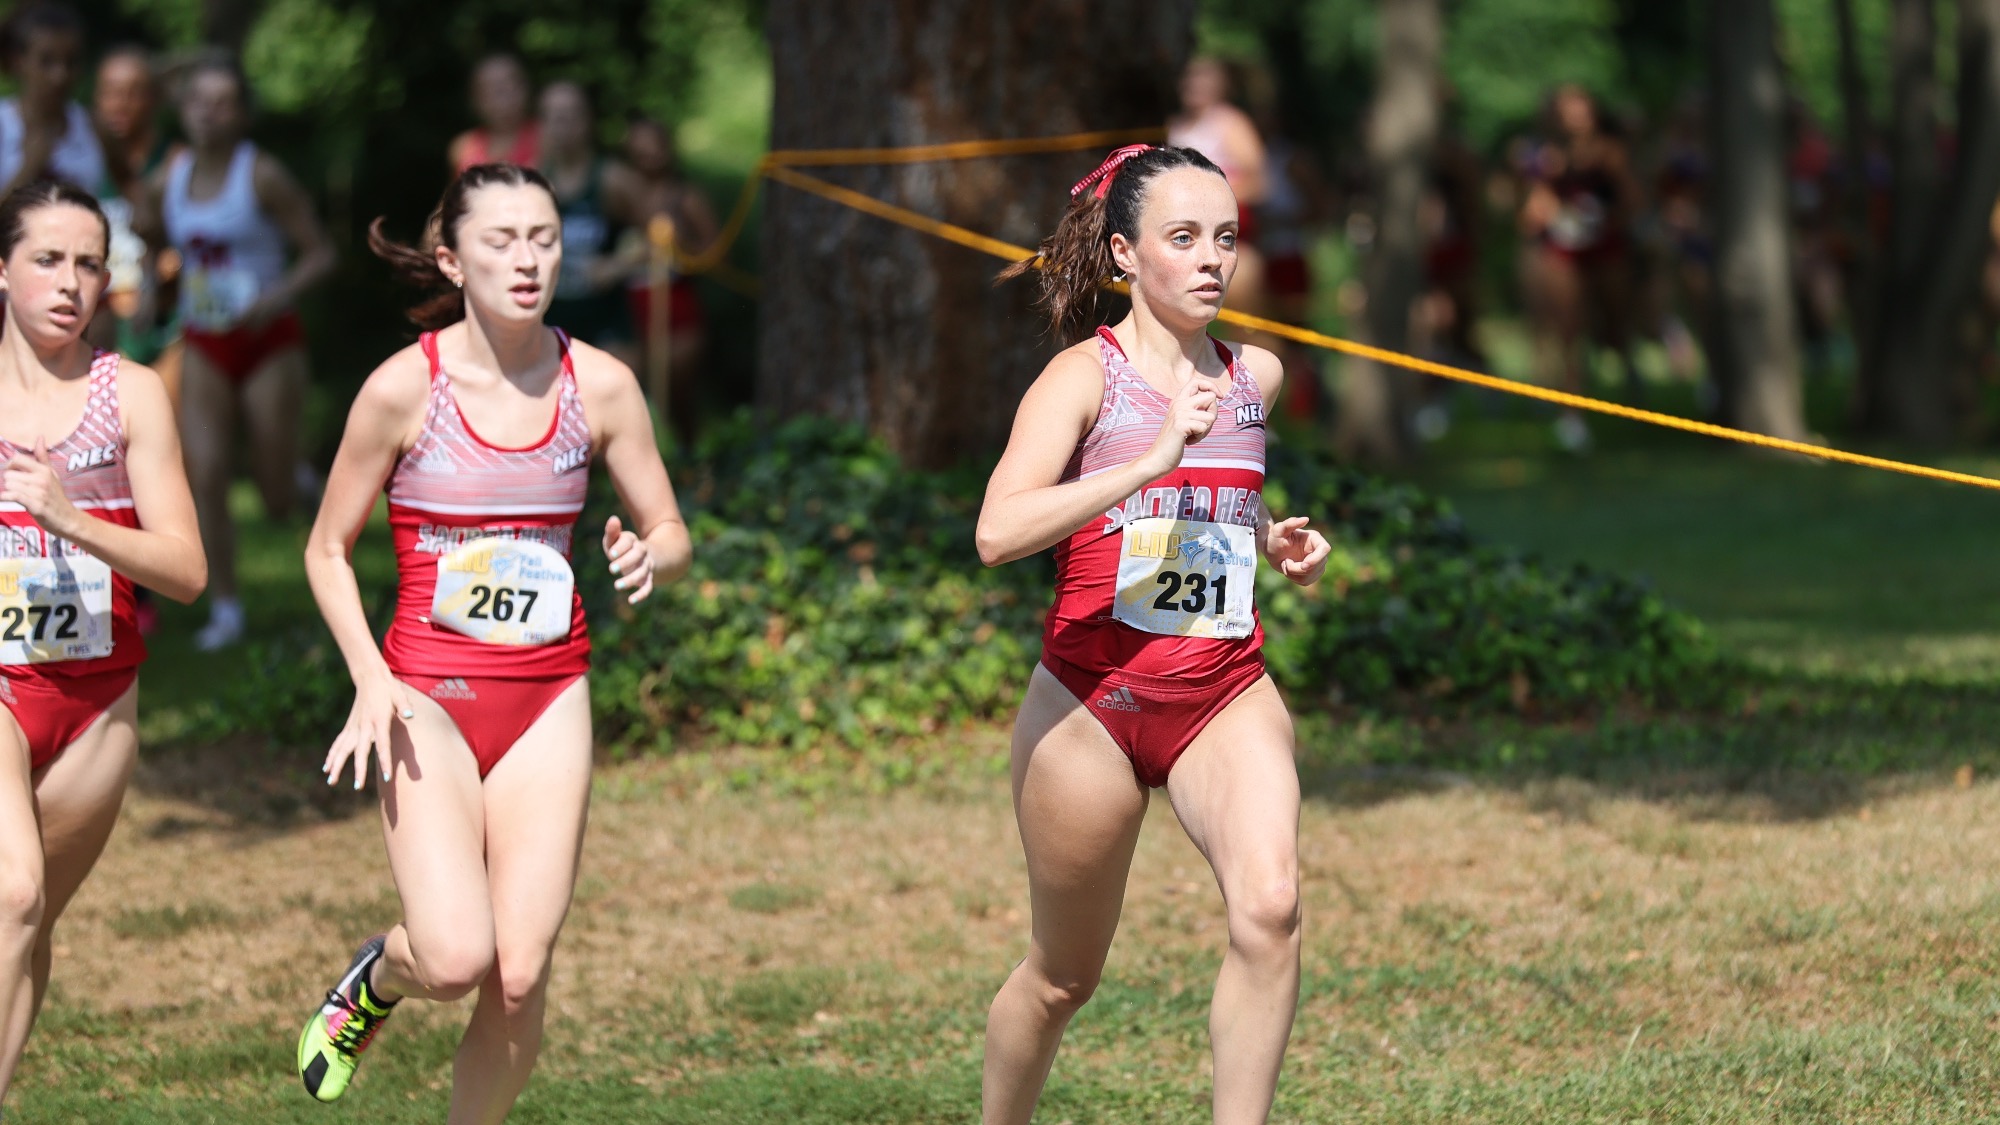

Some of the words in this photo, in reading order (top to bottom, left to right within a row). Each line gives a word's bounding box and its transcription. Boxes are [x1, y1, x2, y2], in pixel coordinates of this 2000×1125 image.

[1101, 411, 1143, 432] adidas
[66, 442, 118, 473] NEC
[552, 443, 590, 475] NEC
[1102, 486, 1212, 535] SACRED
[1213, 486, 1261, 528] HEA
[1129, 531, 1180, 560] LIU
[1211, 536, 1231, 552] Fall
[520, 553, 541, 567] Fall
[1209, 550, 1253, 568] Festival
[519, 566, 567, 582] Festival
[467, 585, 538, 623] 267
[1152, 570, 1227, 615] 231
[2, 604, 78, 641] 272
[429, 688, 478, 701] adidas
[1096, 699, 1141, 712] adidas
